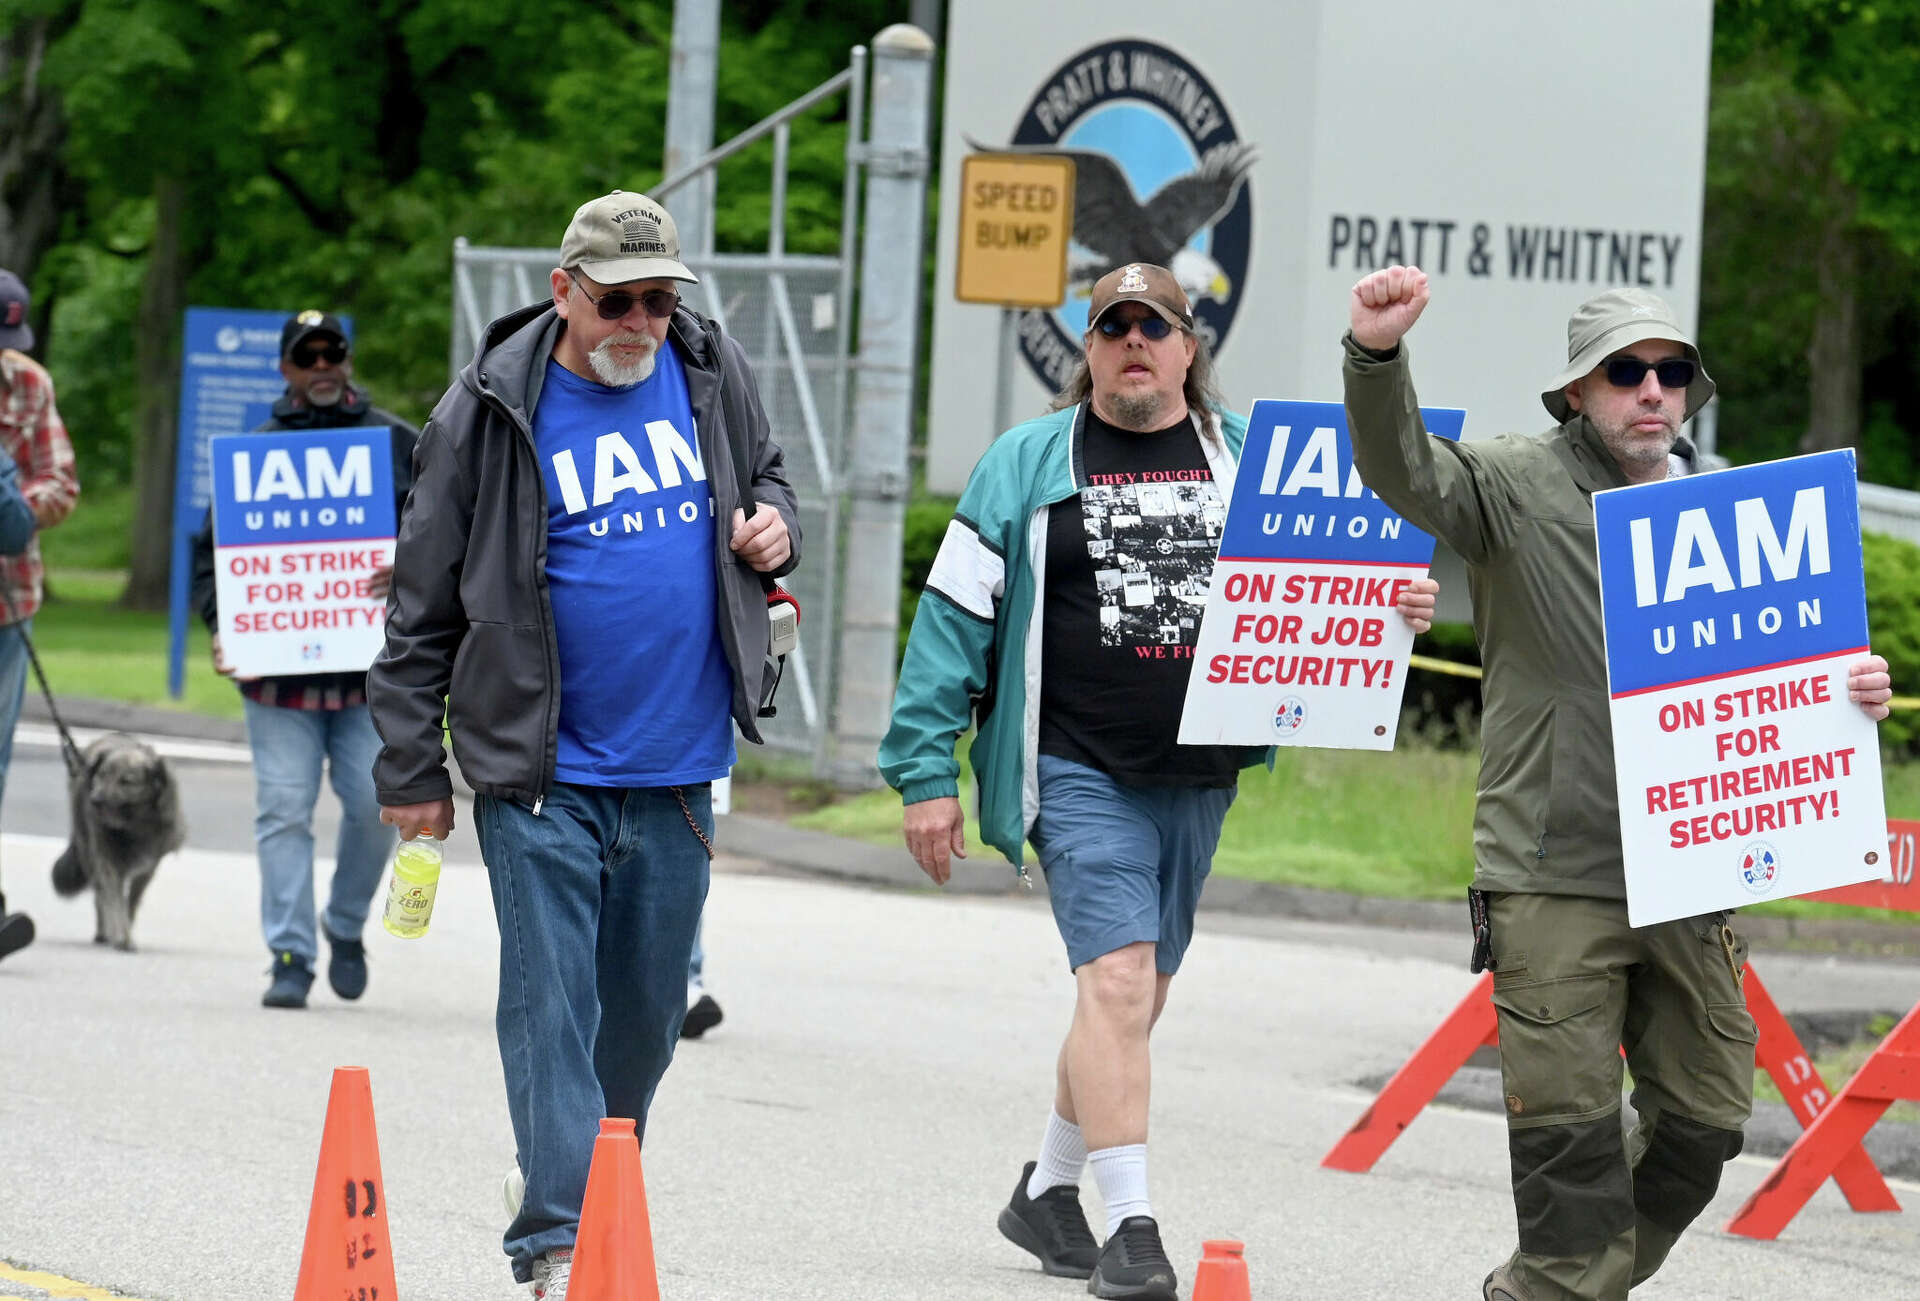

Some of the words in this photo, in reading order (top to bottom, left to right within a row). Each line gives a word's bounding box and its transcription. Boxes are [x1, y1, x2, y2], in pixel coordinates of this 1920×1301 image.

[1108, 50, 1126, 91] &
[974, 182, 1057, 212] SPEED
[611, 209, 661, 225] VETERAN
[620, 242, 666, 253] MARINES
[976, 220, 1051, 250] BUMP
[1329, 214, 1457, 275] PRATT
[1467, 224, 1494, 277] &
[1507, 225, 1682, 287] WHITNEY
[233, 445, 373, 502] IAM
[1090, 472, 1137, 485] THEY
[1143, 469, 1211, 483] FOUGHT
[246, 507, 365, 530] UNION
[1262, 513, 1402, 540] UNION
[230, 556, 270, 576] ON
[281, 550, 385, 574] STRIKE
[1629, 486, 1831, 608] IAM
[248, 583, 304, 604] FOR
[1224, 573, 1275, 603] ON
[1281, 574, 1413, 607] STRIKE
[1232, 614, 1303, 644] FOR
[1310, 617, 1385, 647] JOB
[1653, 598, 1822, 655] UNION
[1135, 646, 1166, 659] WE
[1206, 653, 1394, 689] SECURITY!
[1658, 699, 1705, 733] ON
[1714, 674, 1831, 722] STRIKE
[1715, 724, 1781, 762] FOR
[1646, 747, 1856, 815] RETIREMENT
[1669, 789, 1840, 849] SECURITY!
[399, 896, 428, 909] ZERO
